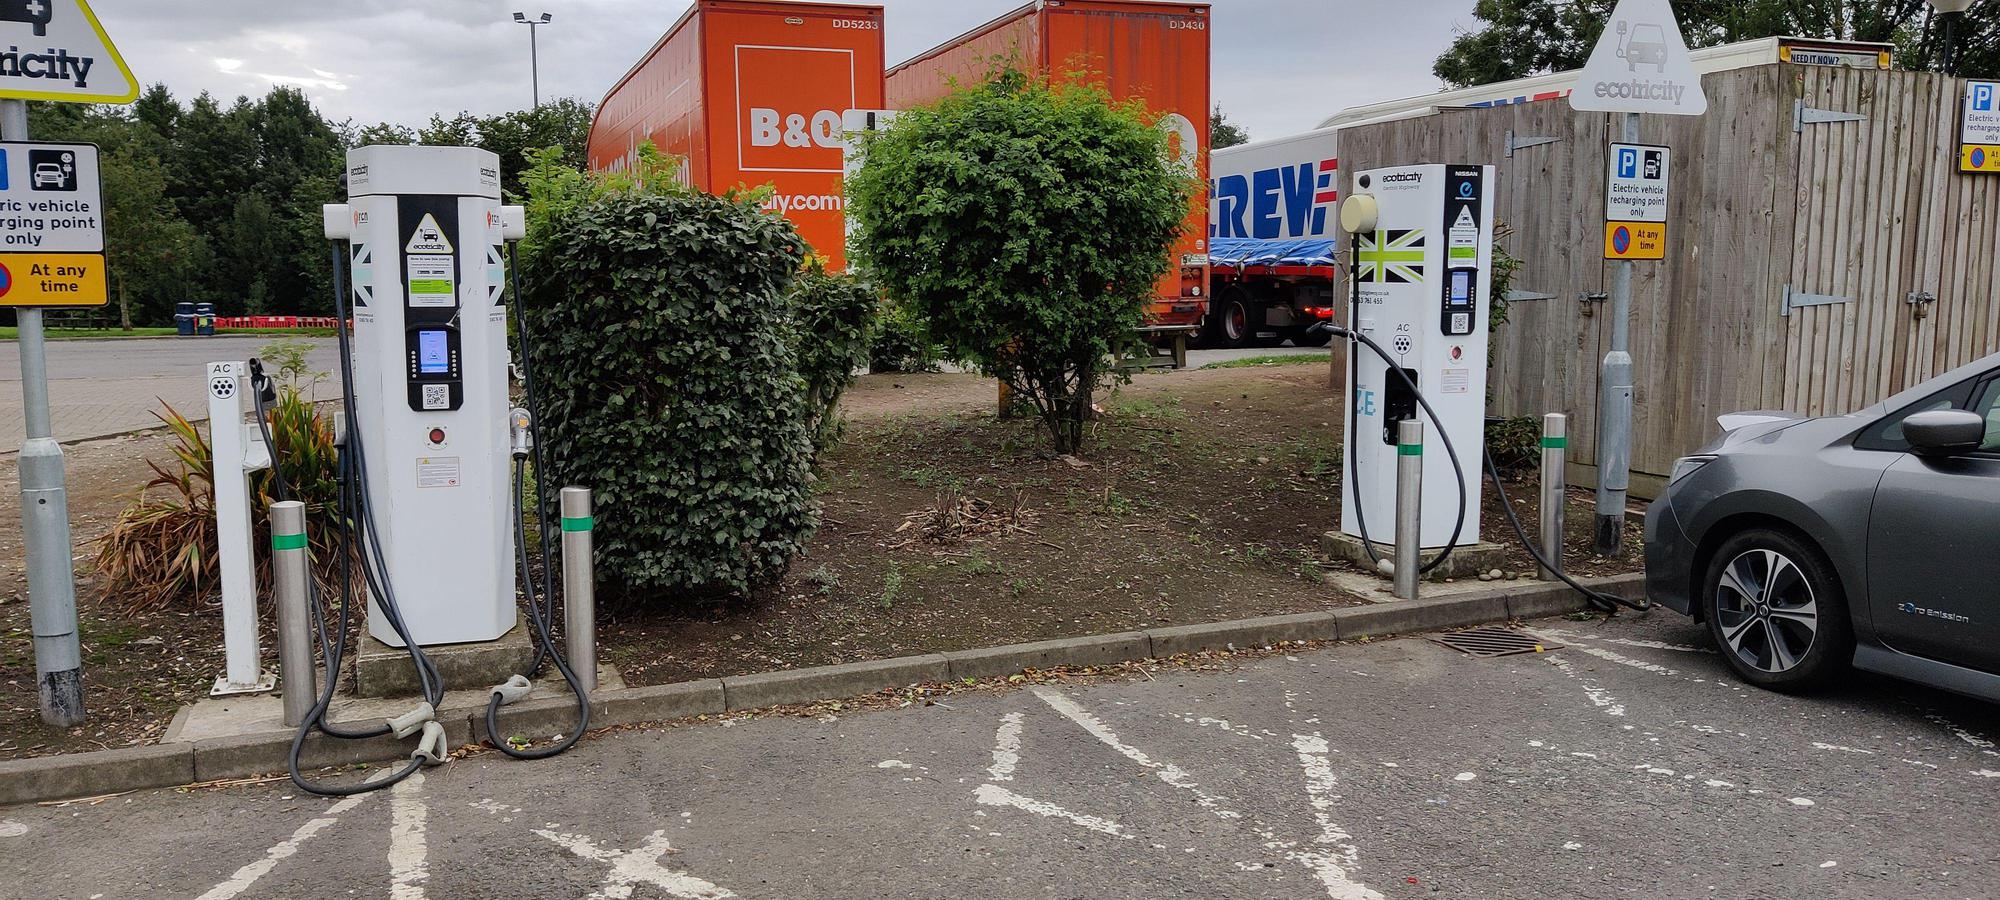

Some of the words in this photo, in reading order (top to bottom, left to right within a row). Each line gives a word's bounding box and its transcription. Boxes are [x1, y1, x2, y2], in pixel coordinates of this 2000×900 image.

[832, 19, 879, 30] DD5233
[1791, 54, 1809, 64] NEED
[1810, 55, 1817, 64] IT
[1818, 56, 1840, 65] NOW?
[1594, 78, 1686, 106] ecotricity
[1968, 114, 1993, 122] Electric
[1383, 171, 1422, 182] ecotricity
[1613, 183, 1639, 193] Electric
[1641, 185, 1664, 195] vehicle
[28, 200, 90, 212] vehicle
[1610, 196, 1646, 206] recharging
[1647, 198, 1665, 207] point
[1630, 208, 1645, 217] only
[51, 217, 96, 231] point
[5, 232, 42, 247] only
[1637, 230, 1645, 238] At
[1646, 231, 1659, 240] any
[1640, 242, 1655, 250] time
[30, 264, 50, 276] At
[56, 266, 86, 279] any
[40, 280, 79, 292] time
[1396, 323, 1411, 332] AC
[212, 363, 232, 374] AC
[1926, 608, 1969, 623] Emission
